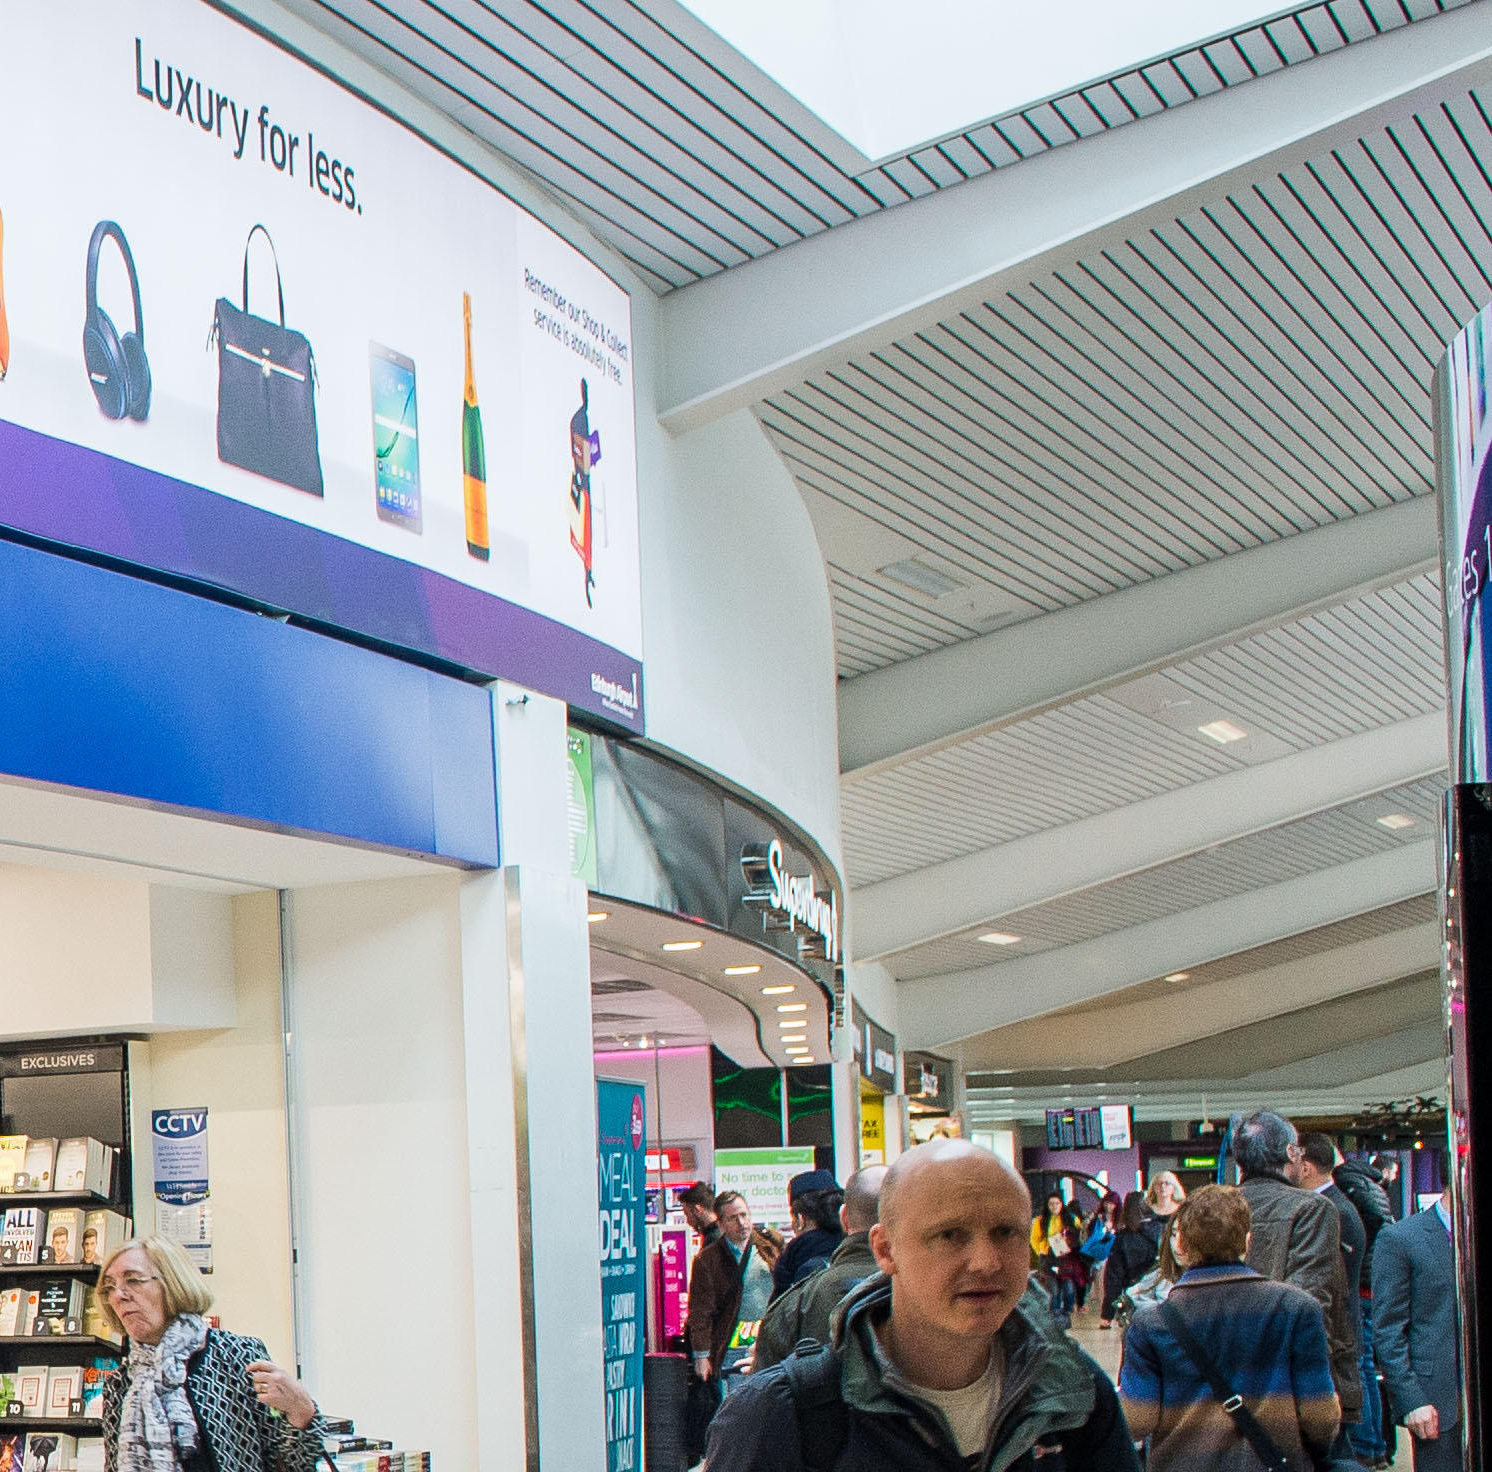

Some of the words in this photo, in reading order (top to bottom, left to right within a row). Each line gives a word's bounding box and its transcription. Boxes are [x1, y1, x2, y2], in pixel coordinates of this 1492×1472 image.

[135, 37, 249, 160] Luxury
[258, 105, 299, 177] for
[308, 132, 362, 215] less.
[524, 268, 566, 314] Remember
[568, 303, 581, 323] our
[582, 309, 600, 342] Shop
[533, 308, 562, 342] service
[21, 1054, 95, 1070] EXCLUSIVES
[155, 1114, 204, 1132] CCTV
[599, 1153, 637, 1202] MEAL
[721, 1173, 738, 1184] No
[742, 1172, 768, 1183] time
[772, 1170, 784, 1182] to
[751, 1185, 788, 1196] docto
[6, 1211, 34, 1227] ALL
[600, 1209, 637, 1261] DEAL
